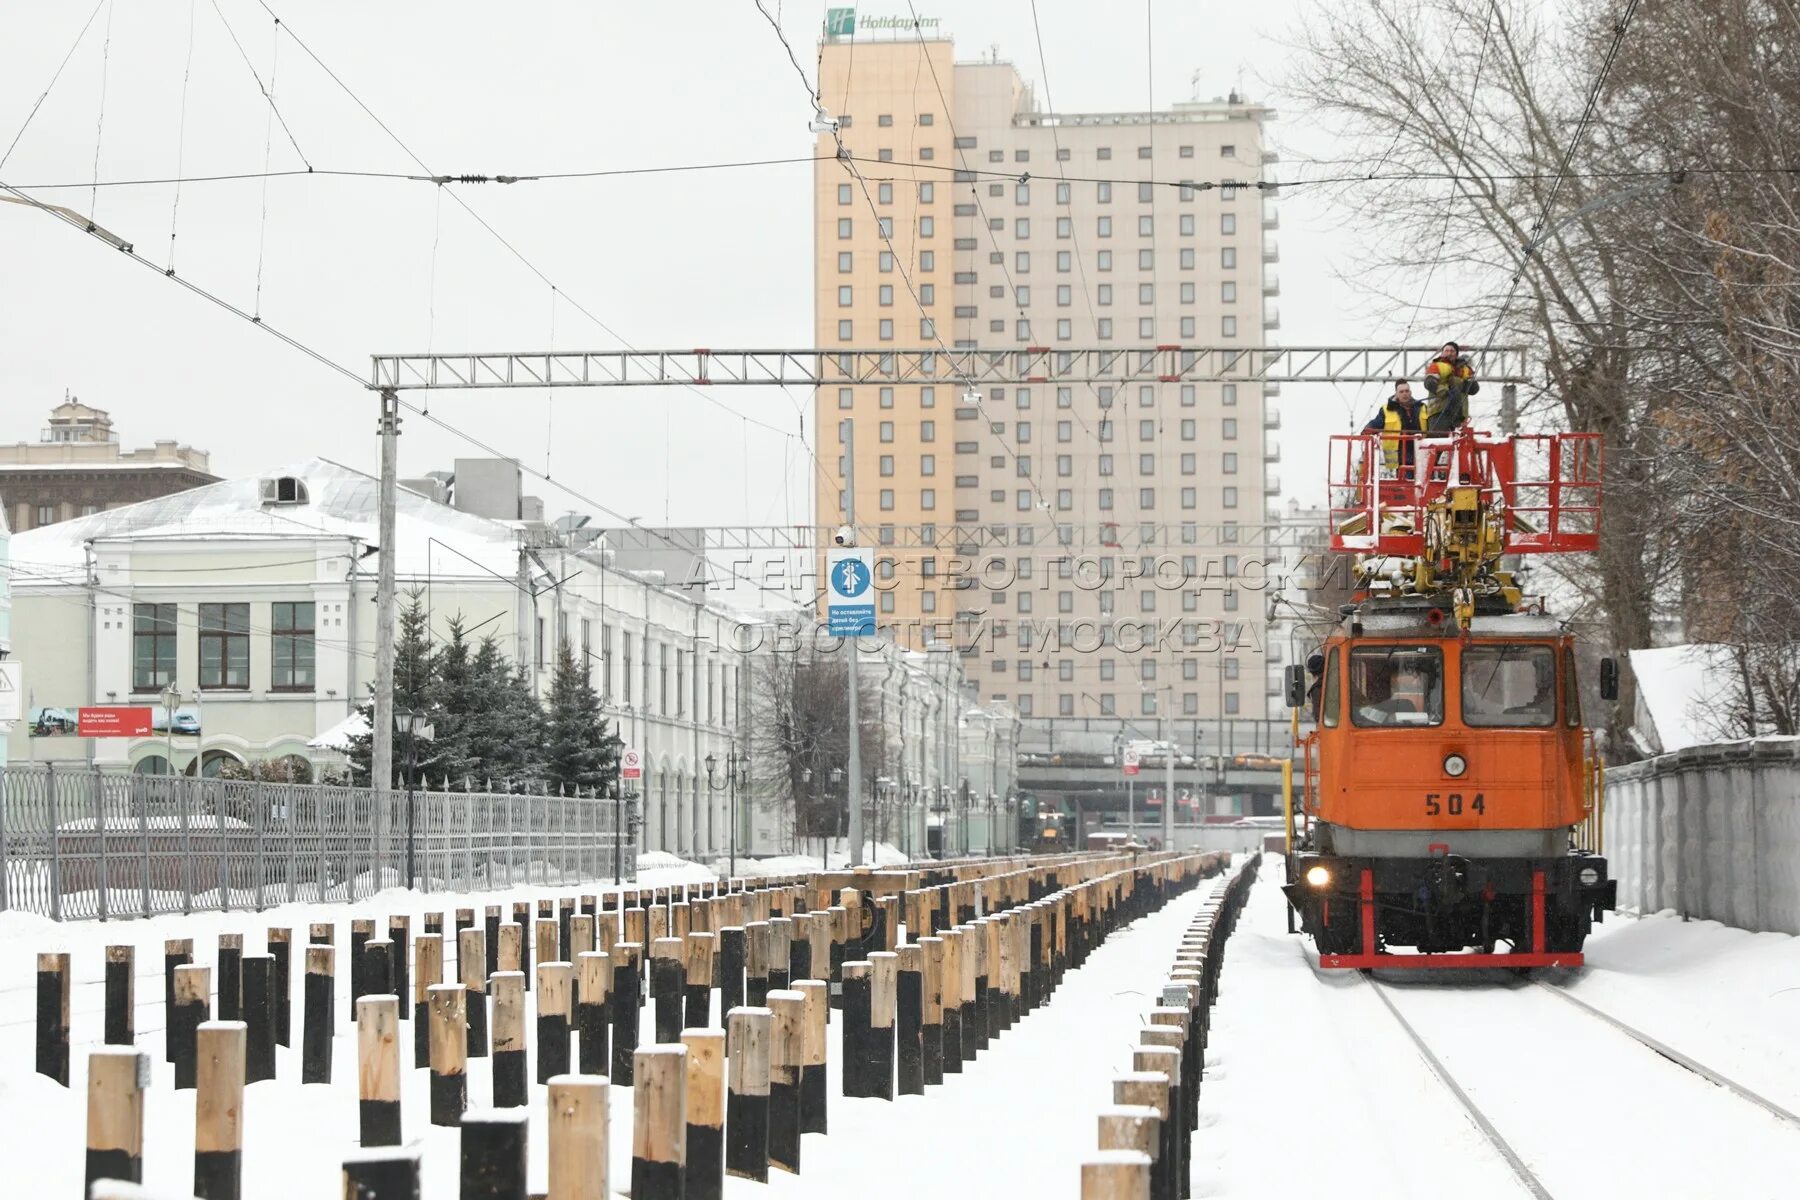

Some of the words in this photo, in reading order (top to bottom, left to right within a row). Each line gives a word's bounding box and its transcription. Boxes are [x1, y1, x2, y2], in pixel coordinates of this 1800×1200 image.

[860, 14, 914, 31] Holiday
[916, 14, 939, 27] Inn
[1151, 789, 1157, 799] 1
[1182, 789, 1189, 799] 2
[1426, 793, 1485, 816] 504
